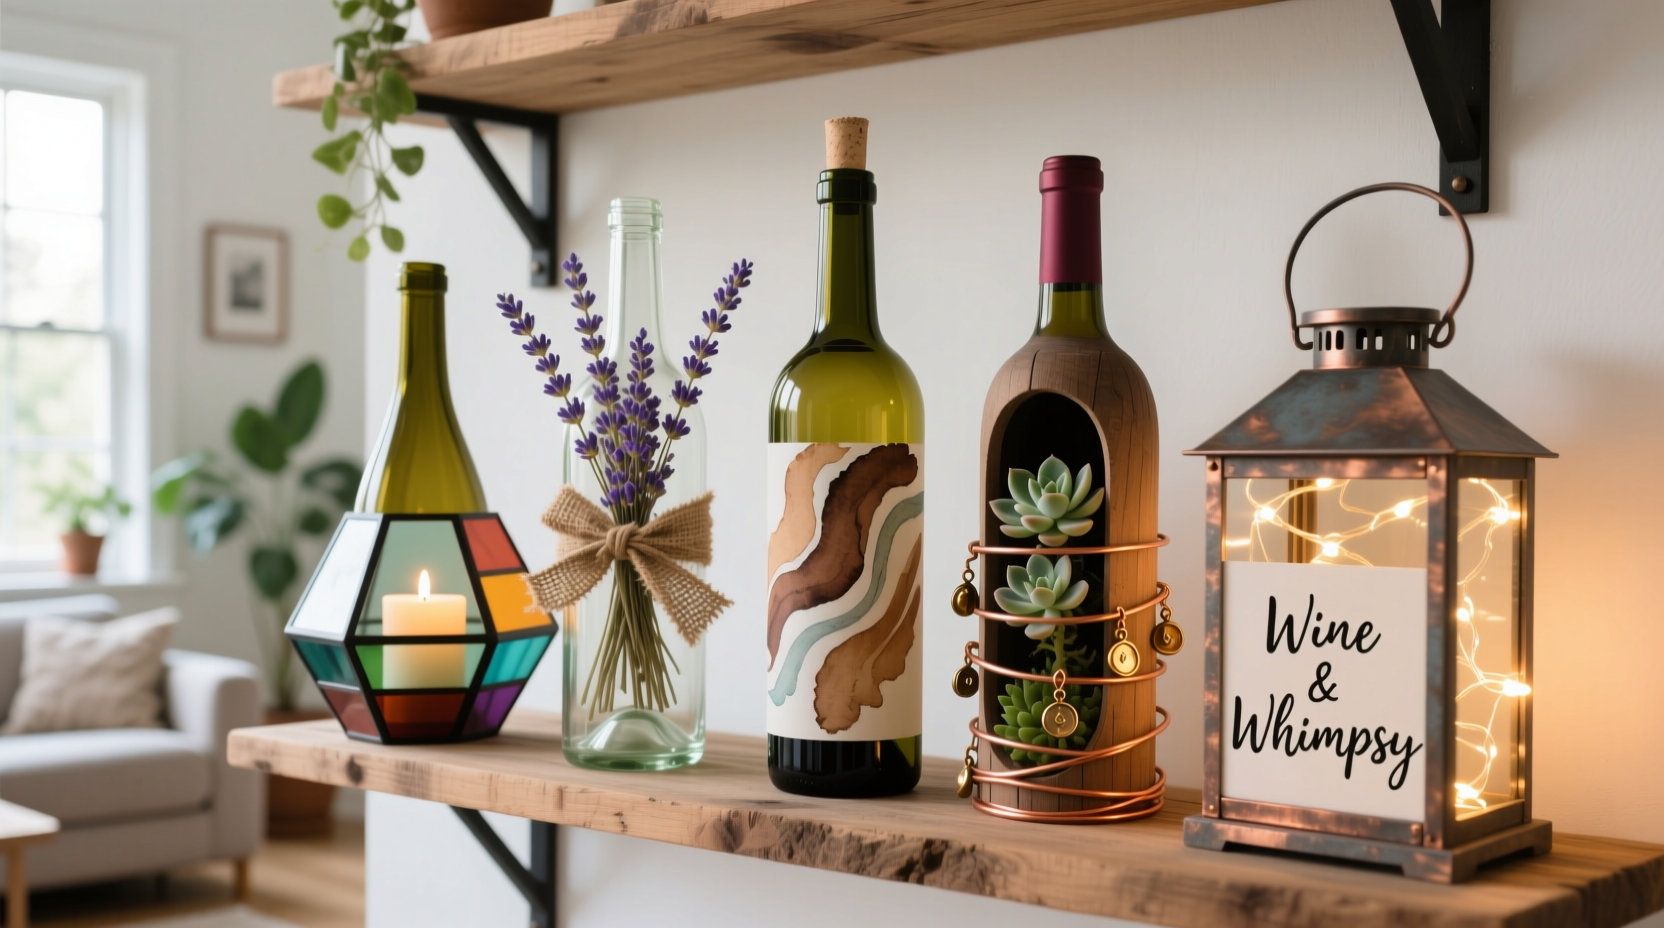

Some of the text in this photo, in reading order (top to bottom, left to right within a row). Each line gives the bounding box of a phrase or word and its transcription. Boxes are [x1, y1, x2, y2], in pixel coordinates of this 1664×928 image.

[1266, 593, 1382, 654] Wine
[1308, 661, 1339, 703] &
[1232, 693, 1424, 790] Whimpsy
